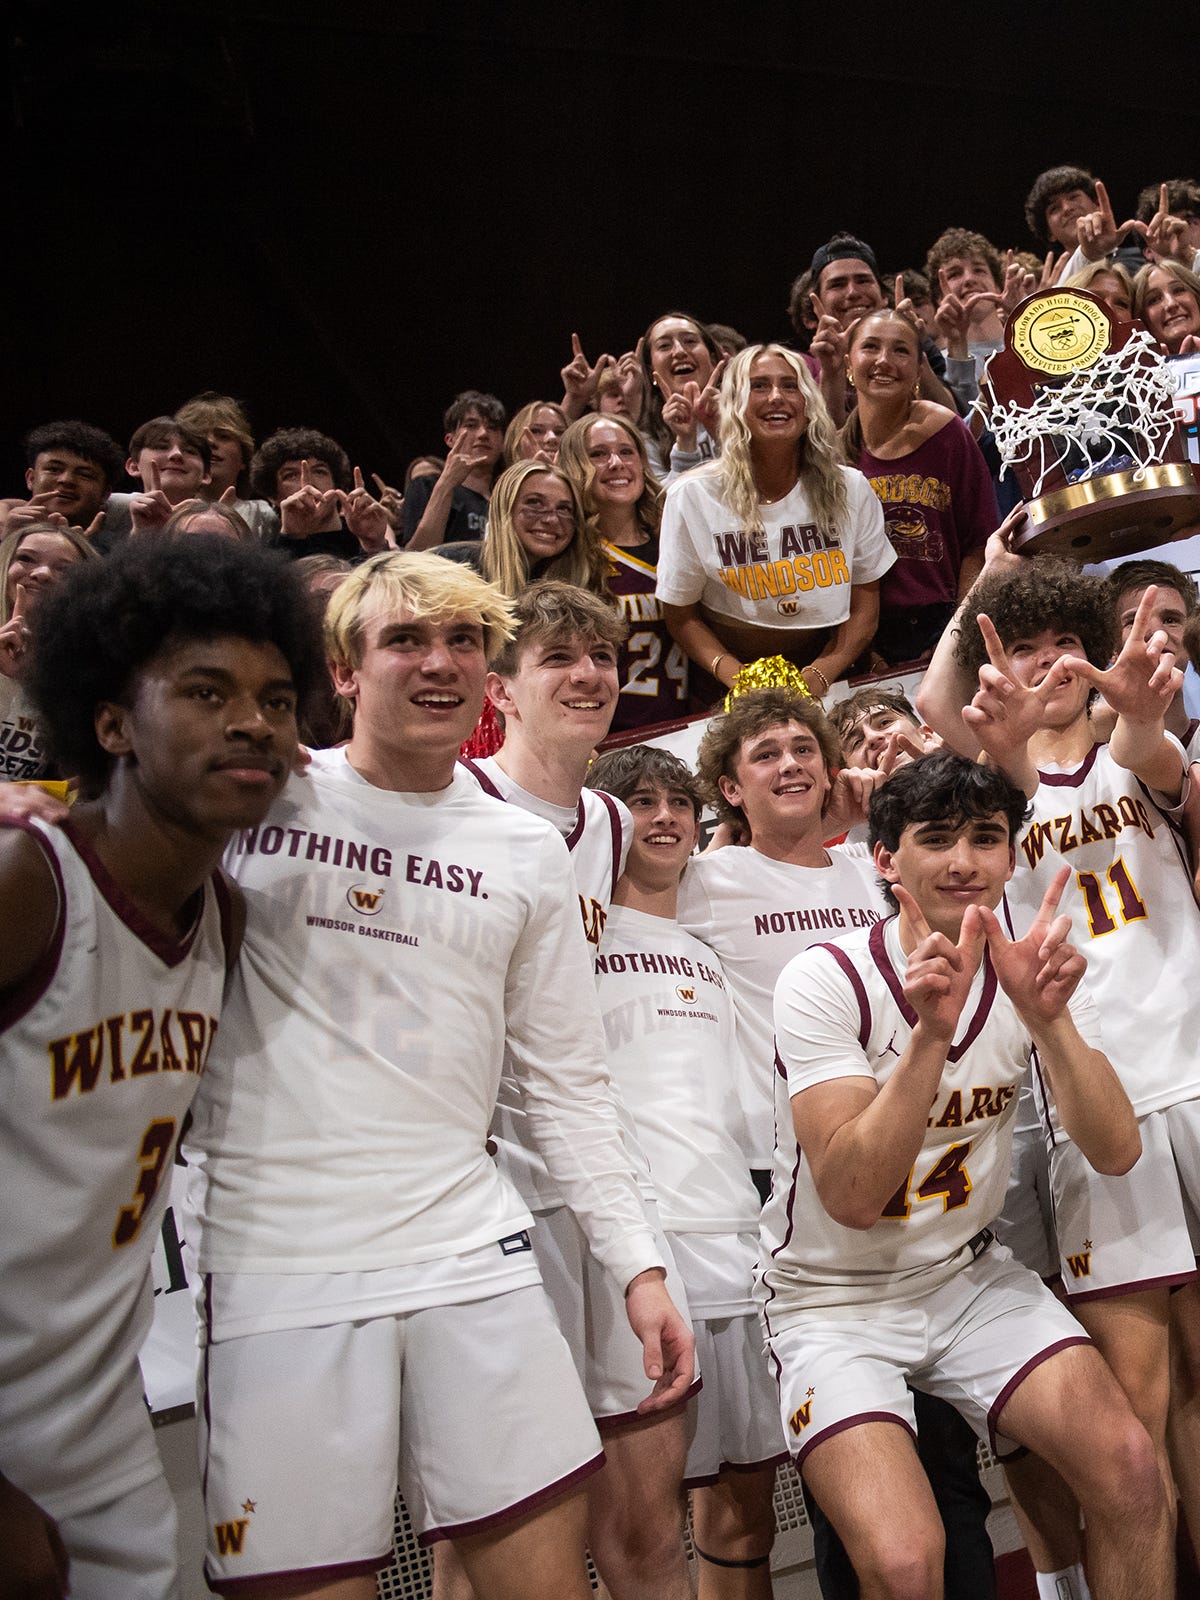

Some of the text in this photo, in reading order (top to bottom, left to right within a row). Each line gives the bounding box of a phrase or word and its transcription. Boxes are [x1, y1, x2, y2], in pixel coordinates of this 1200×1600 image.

[1018, 298, 1101, 342] COLORADO HIGH SCHOOL
[1022, 348, 1067, 371] ACTIVITIES
[713, 522, 842, 568] WE ARE
[718, 549, 850, 601] WINDSOR
[620, 632, 688, 700] 24
[1021, 796, 1155, 871] WIZARDS
[236, 825, 489, 900] NOTHING EASY.
[1076, 854, 1149, 939] 11
[306, 915, 420, 947] WINDSOR BASKETBALL
[754, 908, 846, 935] NOTHING
[595, 953, 695, 979] NOTHING
[657, 1009, 719, 1022] WINDSOR BASKETBALL
[1065, 1252, 1091, 1279] W
[789, 1398, 813, 1437] W
[214, 1518, 251, 1556] W
